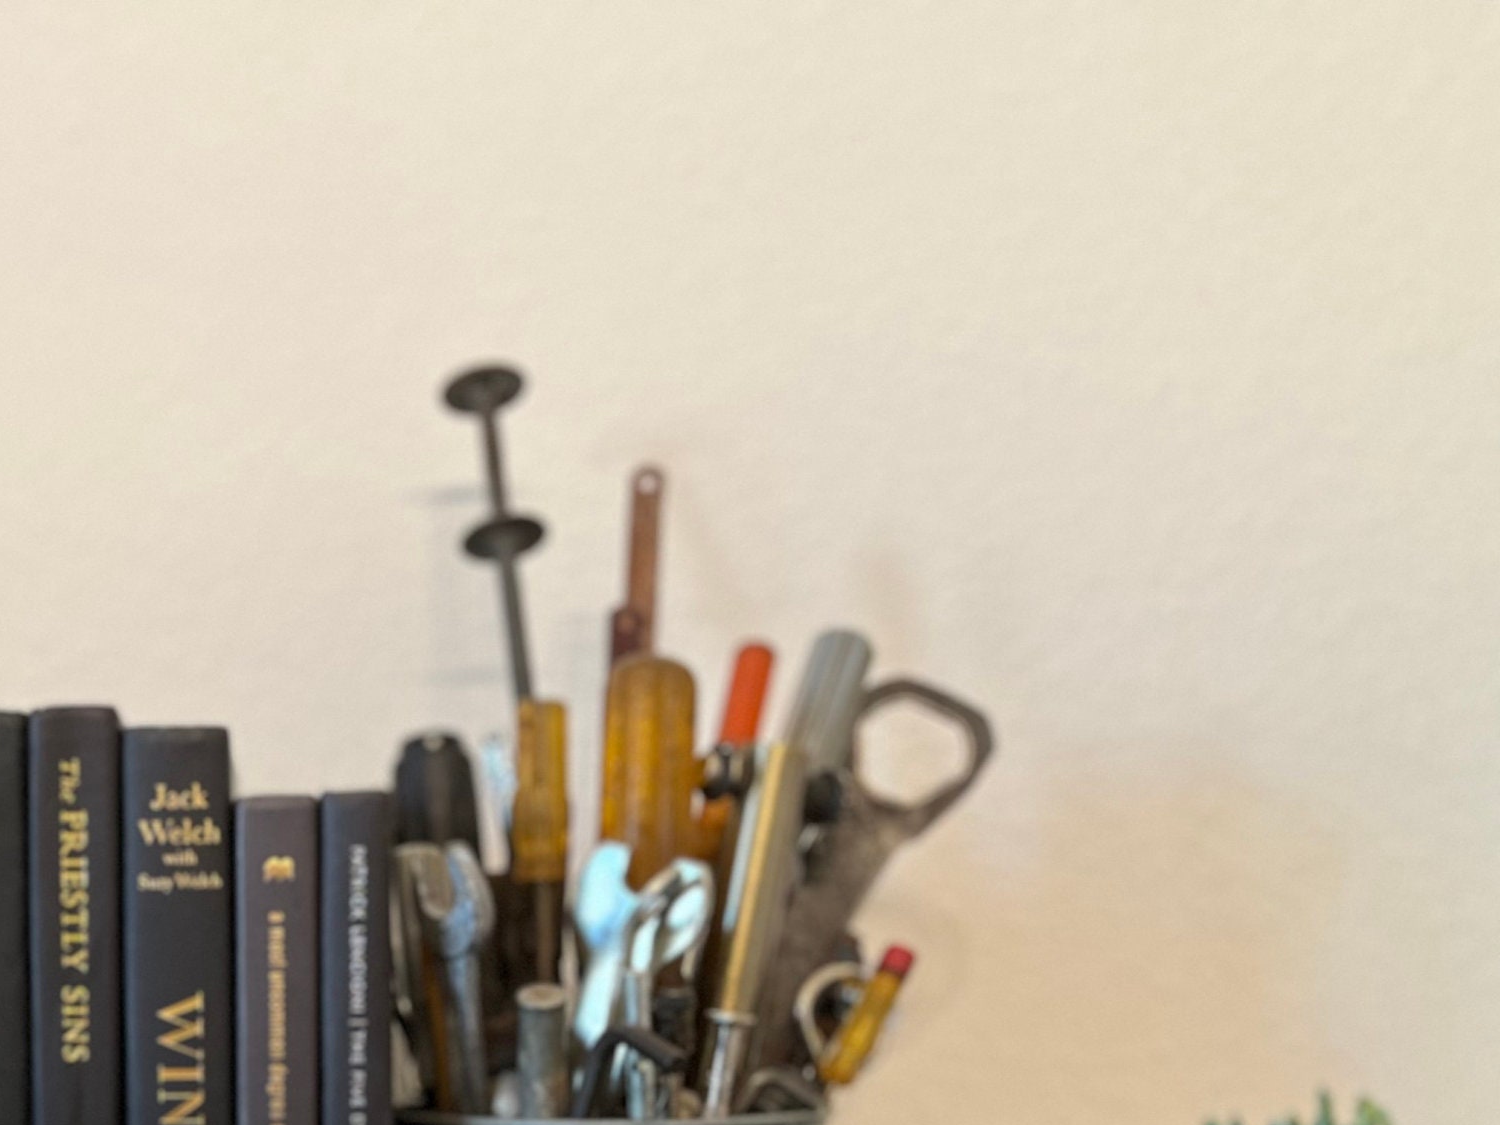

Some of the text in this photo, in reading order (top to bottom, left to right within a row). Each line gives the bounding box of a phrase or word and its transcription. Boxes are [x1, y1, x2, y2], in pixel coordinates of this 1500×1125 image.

[148, 781, 209, 812] Jack
[136, 817, 221, 846] Welch
[162, 848, 199, 866] with
[58, 757, 91, 1063] The PRIESTLY SINS
